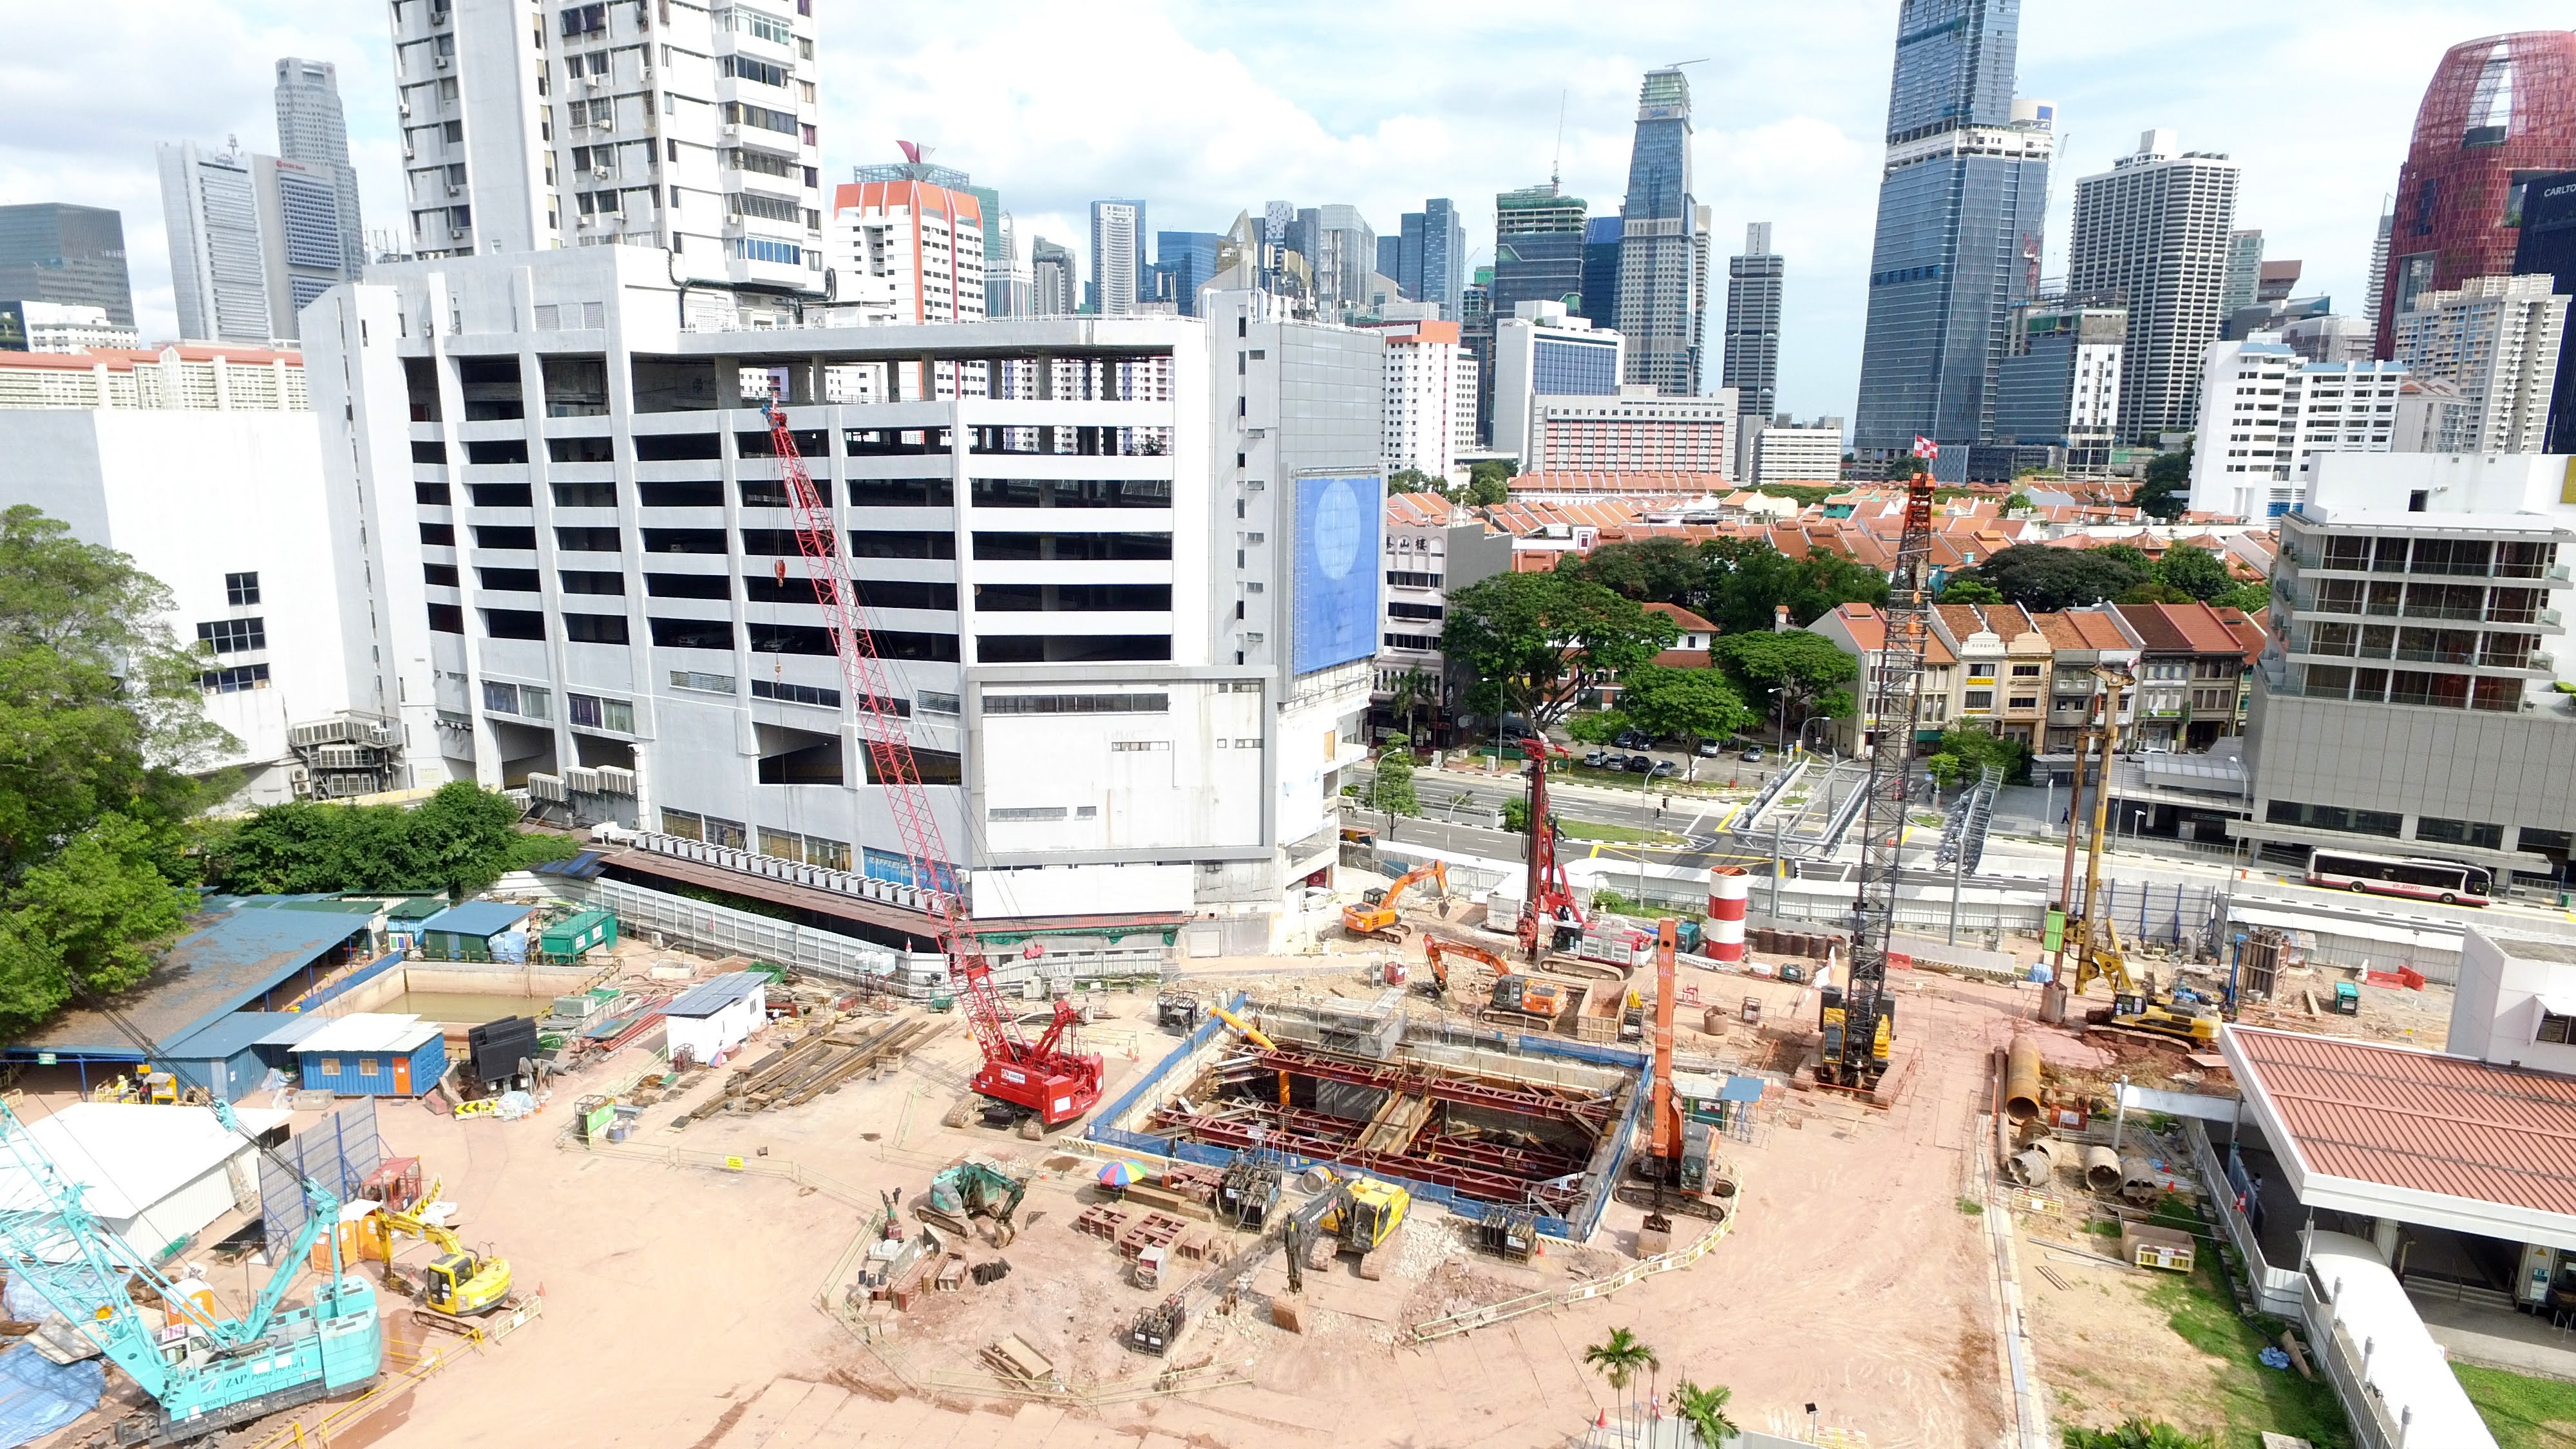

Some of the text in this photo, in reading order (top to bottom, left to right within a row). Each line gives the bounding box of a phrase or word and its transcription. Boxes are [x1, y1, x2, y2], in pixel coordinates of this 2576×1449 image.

[2544, 184, 2576, 196] CARLTO
[1309, 1206, 1327, 1224] VOLVO
[225, 1373, 247, 1388] ZAP
[251, 1370, 273, 1381] Piling
